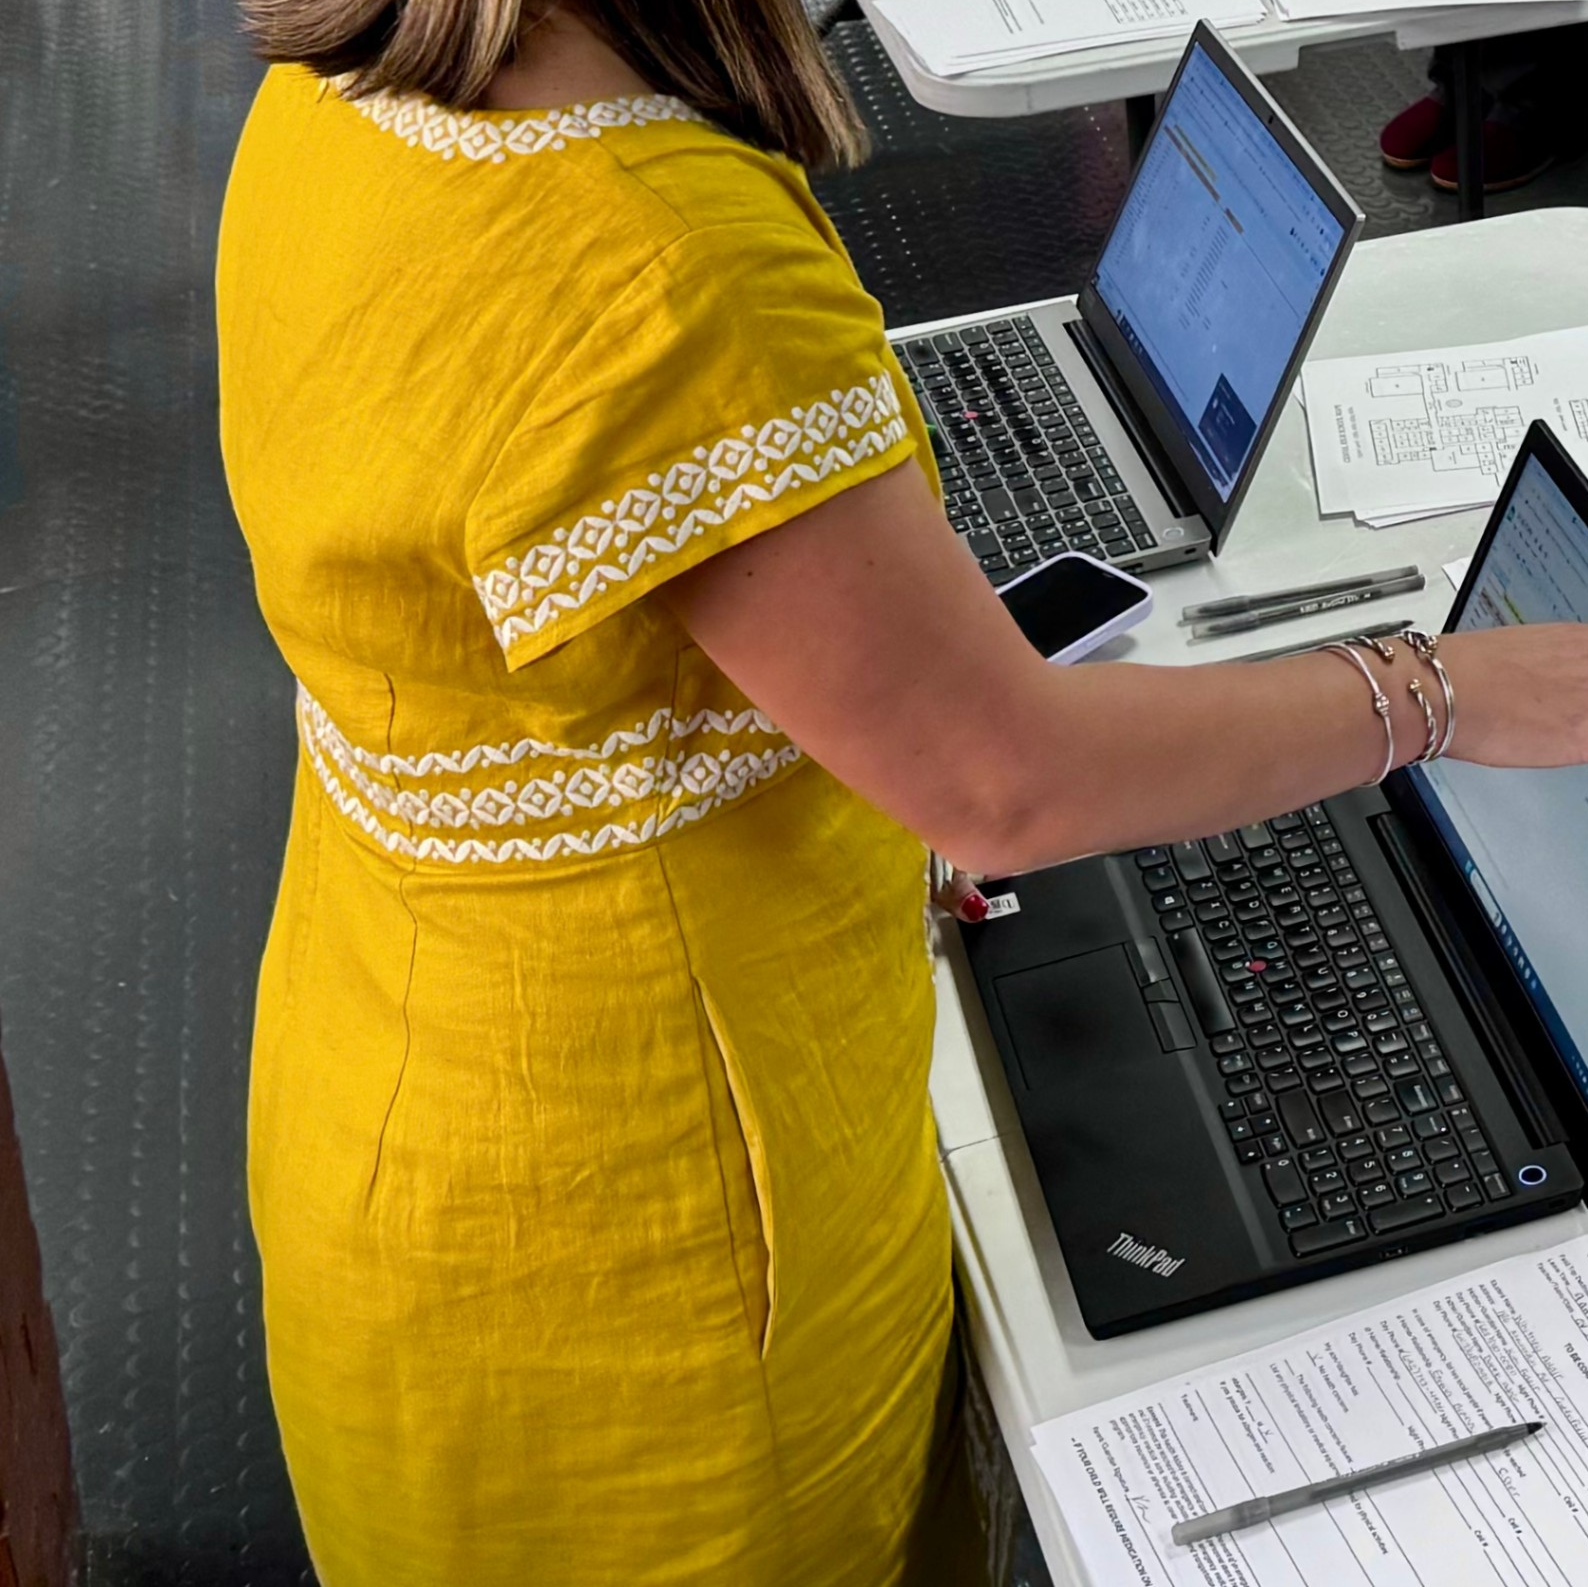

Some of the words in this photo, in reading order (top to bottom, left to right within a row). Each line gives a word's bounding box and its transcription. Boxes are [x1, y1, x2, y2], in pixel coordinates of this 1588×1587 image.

[1107, 1232, 1186, 1277] ThinkPad
[1563, 1342, 1575, 1353] TO
[1074, 1448, 1093, 1467] YOUR
[1083, 1466, 1104, 1486] CHILD
[1113, 1532, 1153, 1576] MEDICATION
